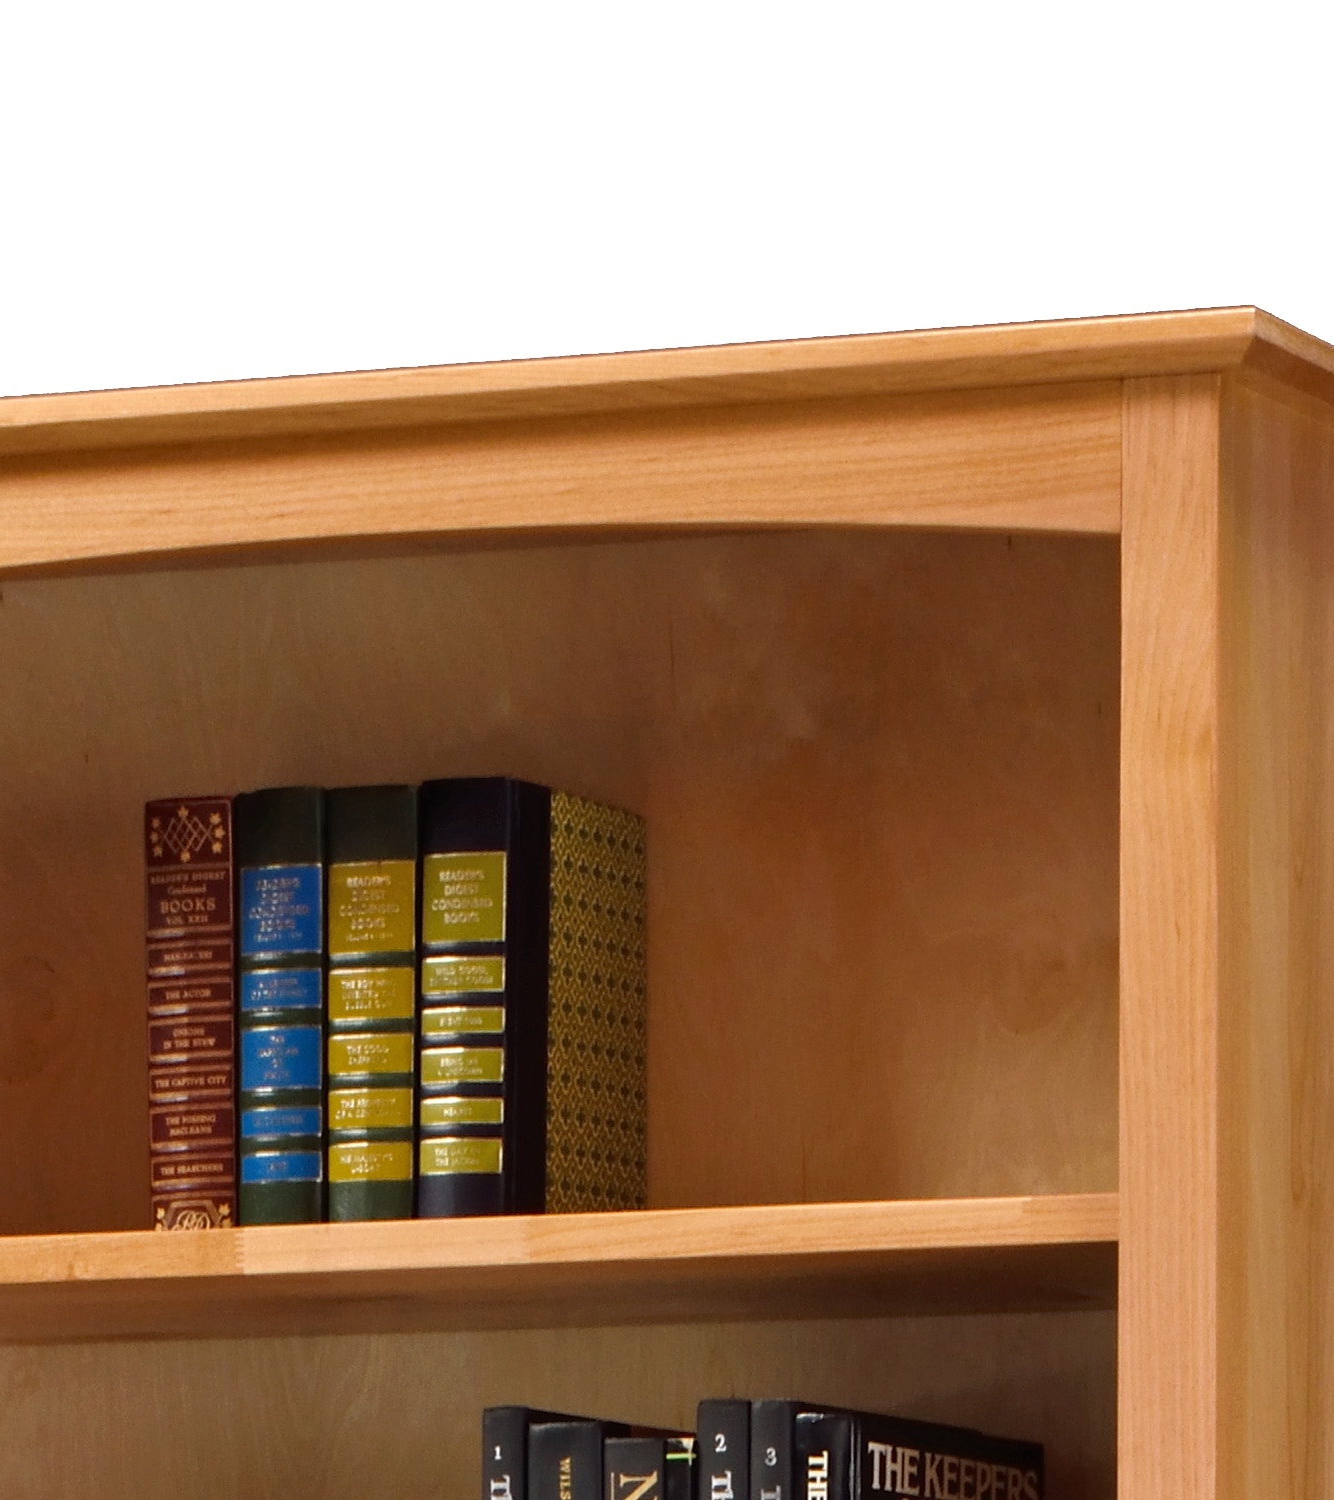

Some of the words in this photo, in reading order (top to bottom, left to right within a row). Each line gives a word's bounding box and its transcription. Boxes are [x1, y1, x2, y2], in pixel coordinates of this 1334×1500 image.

[160, 897, 216, 914] BOOKS
[715, 1434, 727, 1453] 2
[494, 1446, 502, 1460] 1
[765, 1448, 777, 1466] 3
[868, 1440, 920, 1496] THE
